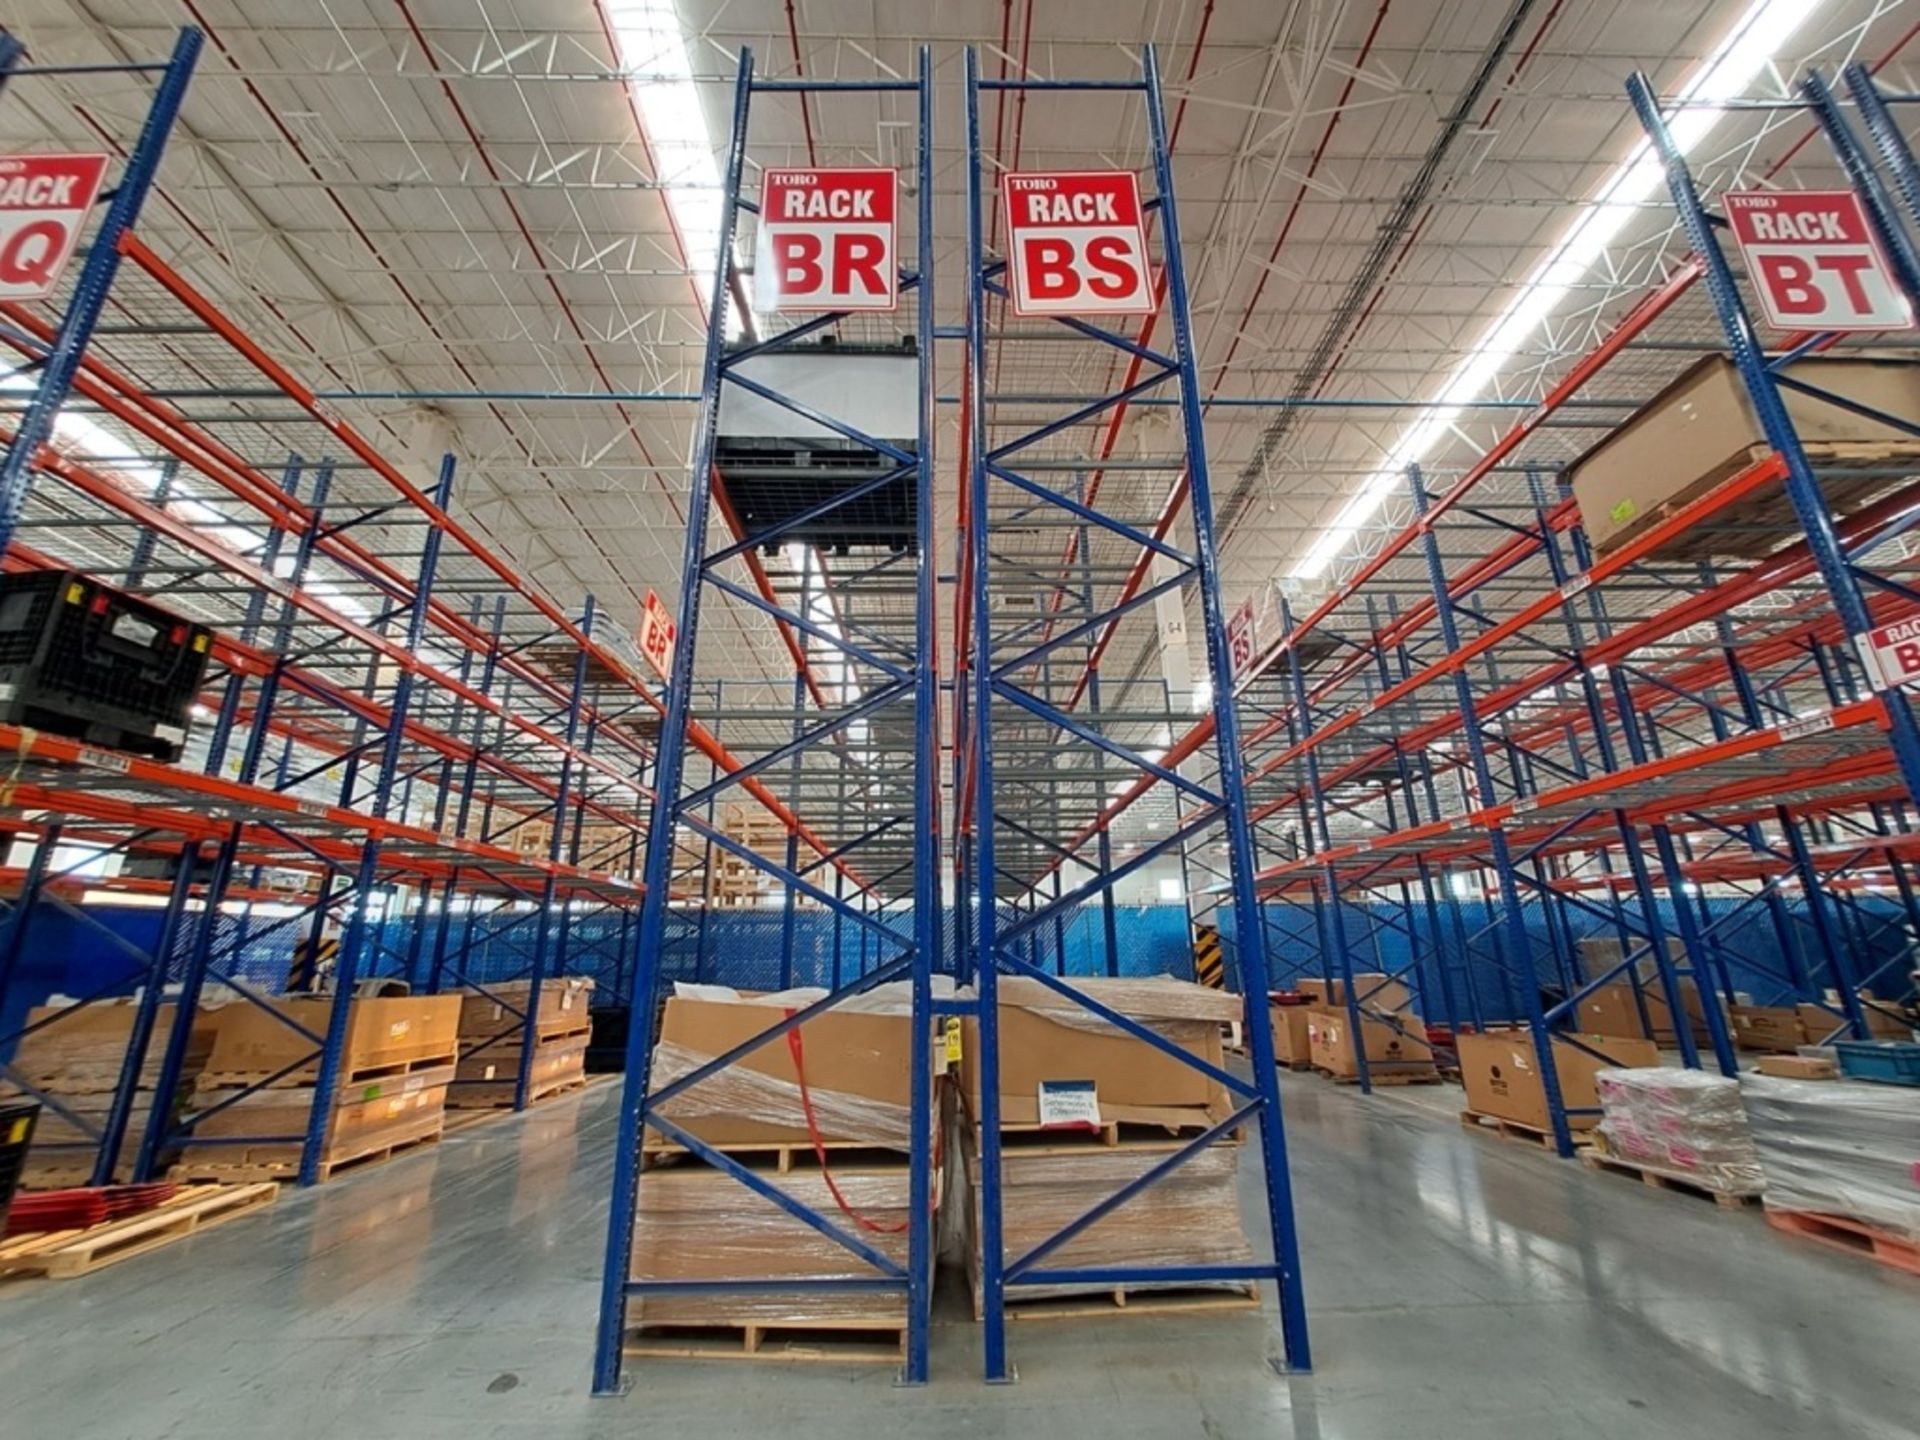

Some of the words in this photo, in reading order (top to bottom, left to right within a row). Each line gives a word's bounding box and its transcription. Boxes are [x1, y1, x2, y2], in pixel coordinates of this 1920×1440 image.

[771, 174, 818, 185] TORO
[1011, 179, 1058, 190] TORO
[784, 189, 875, 218] RACK
[1028, 193, 1120, 222] RACK
[1750, 211, 1848, 240] RACK
[772, 233, 888, 295] BR
[1024, 236, 1139, 299] BS
[1757, 255, 1874, 315] BT
